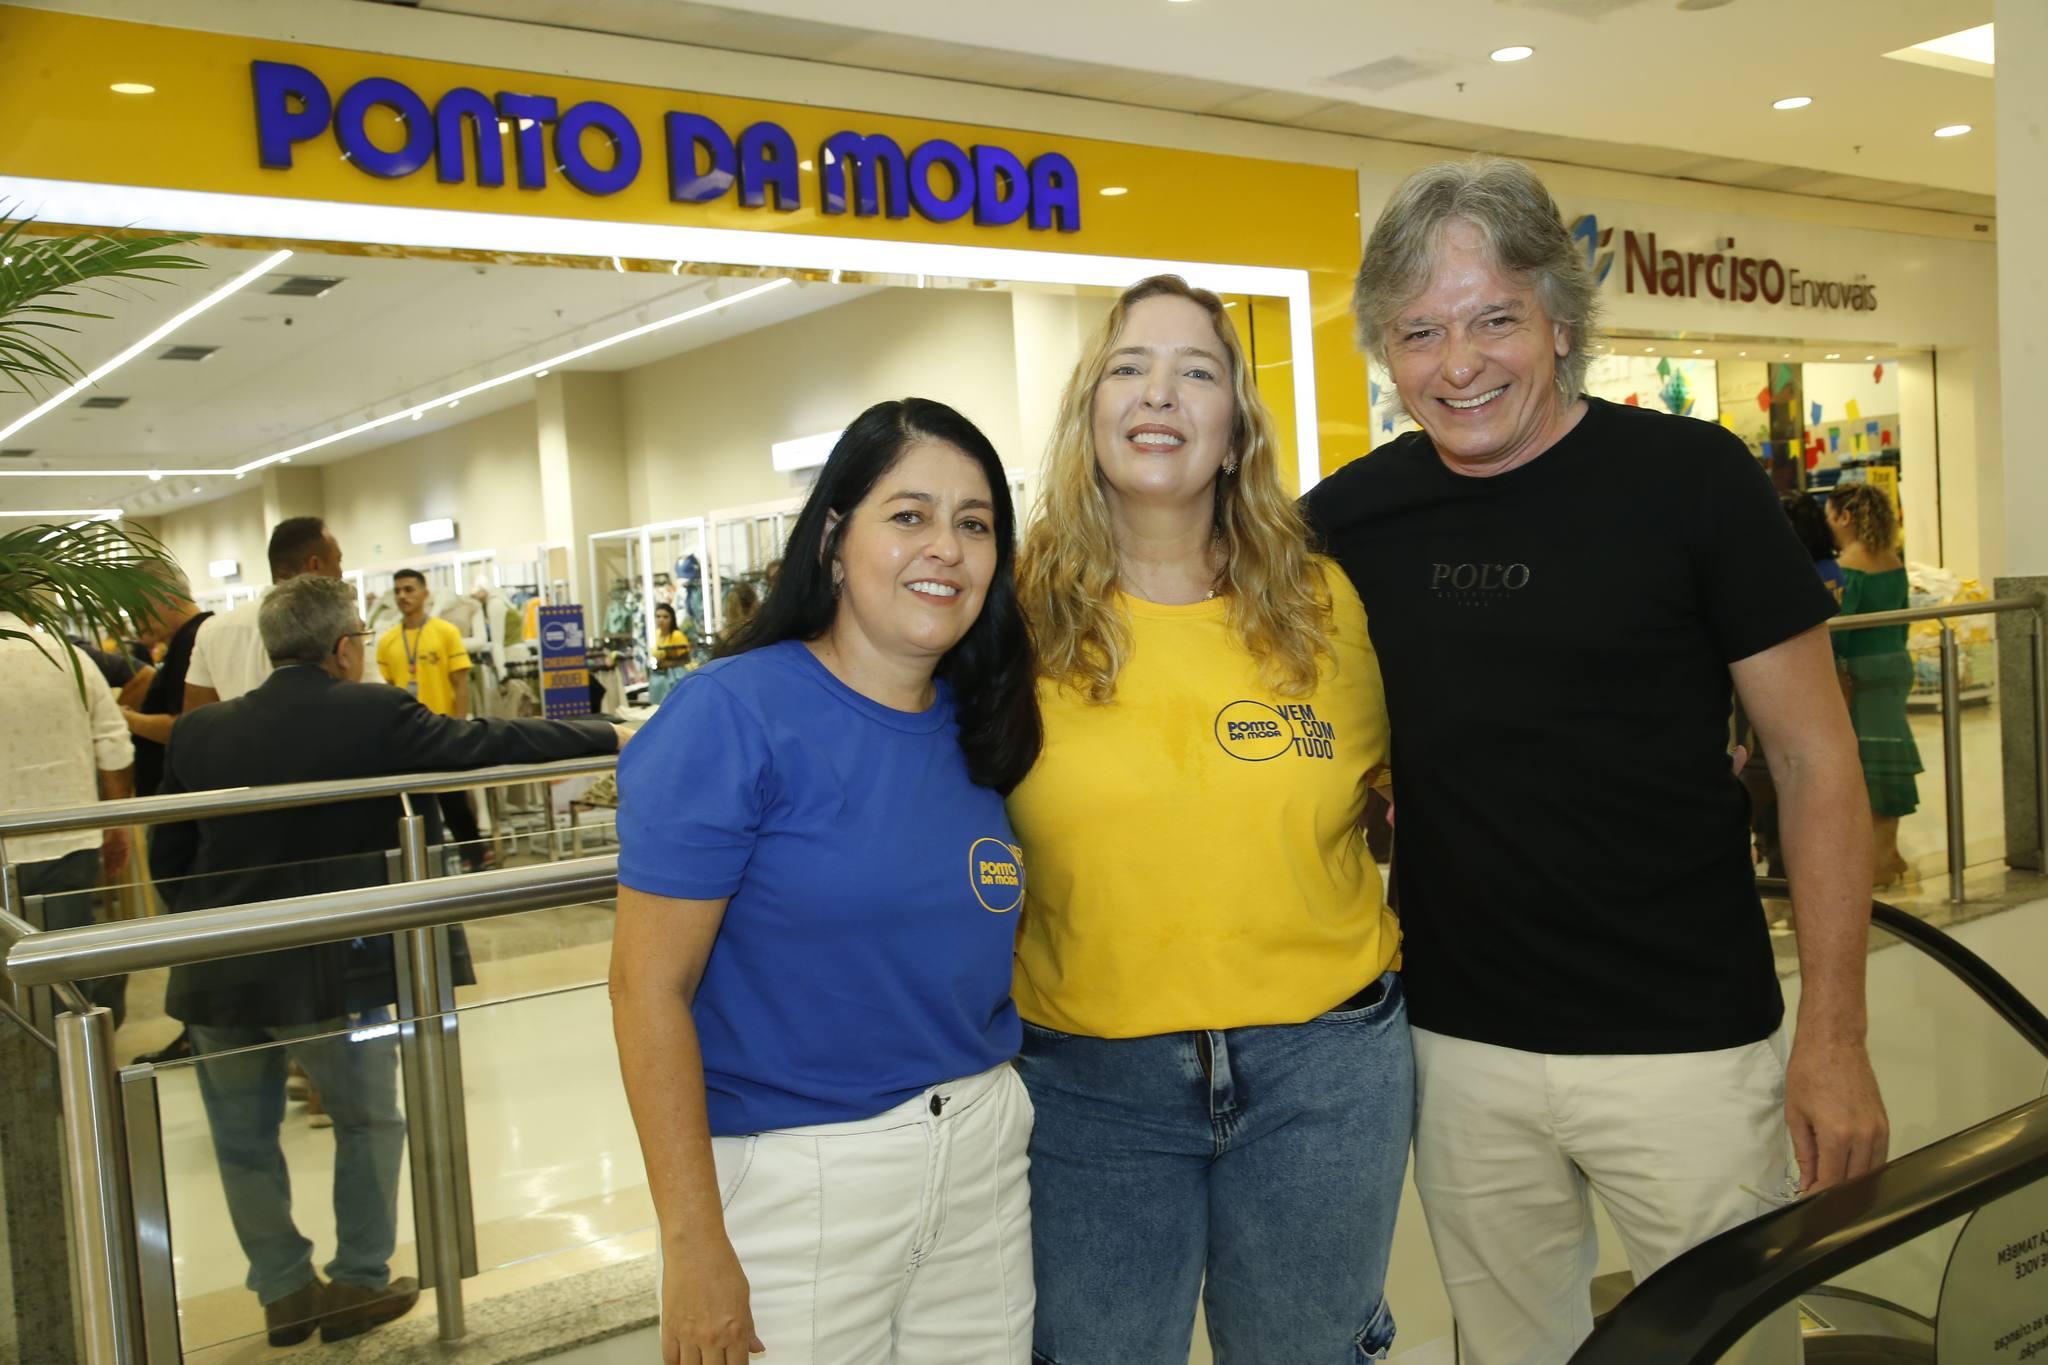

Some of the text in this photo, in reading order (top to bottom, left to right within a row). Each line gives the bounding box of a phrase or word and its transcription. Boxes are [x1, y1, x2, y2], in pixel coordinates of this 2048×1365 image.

[251, 60, 1081, 233] PONTO DA MODA
[1624, 230, 1878, 312] Narciso Enxovais
[1430, 563, 1530, 590] POLO
[1276, 704, 1316, 721] VEM
[1227, 721, 1278, 732] PONTO
[1301, 720, 1336, 740] COM
[1230, 731, 1282, 741] DA MODA
[1293, 737, 1334, 760] TUDO
[979, 861, 1017, 876] PONTO
[981, 875, 1019, 886] DA MODA
